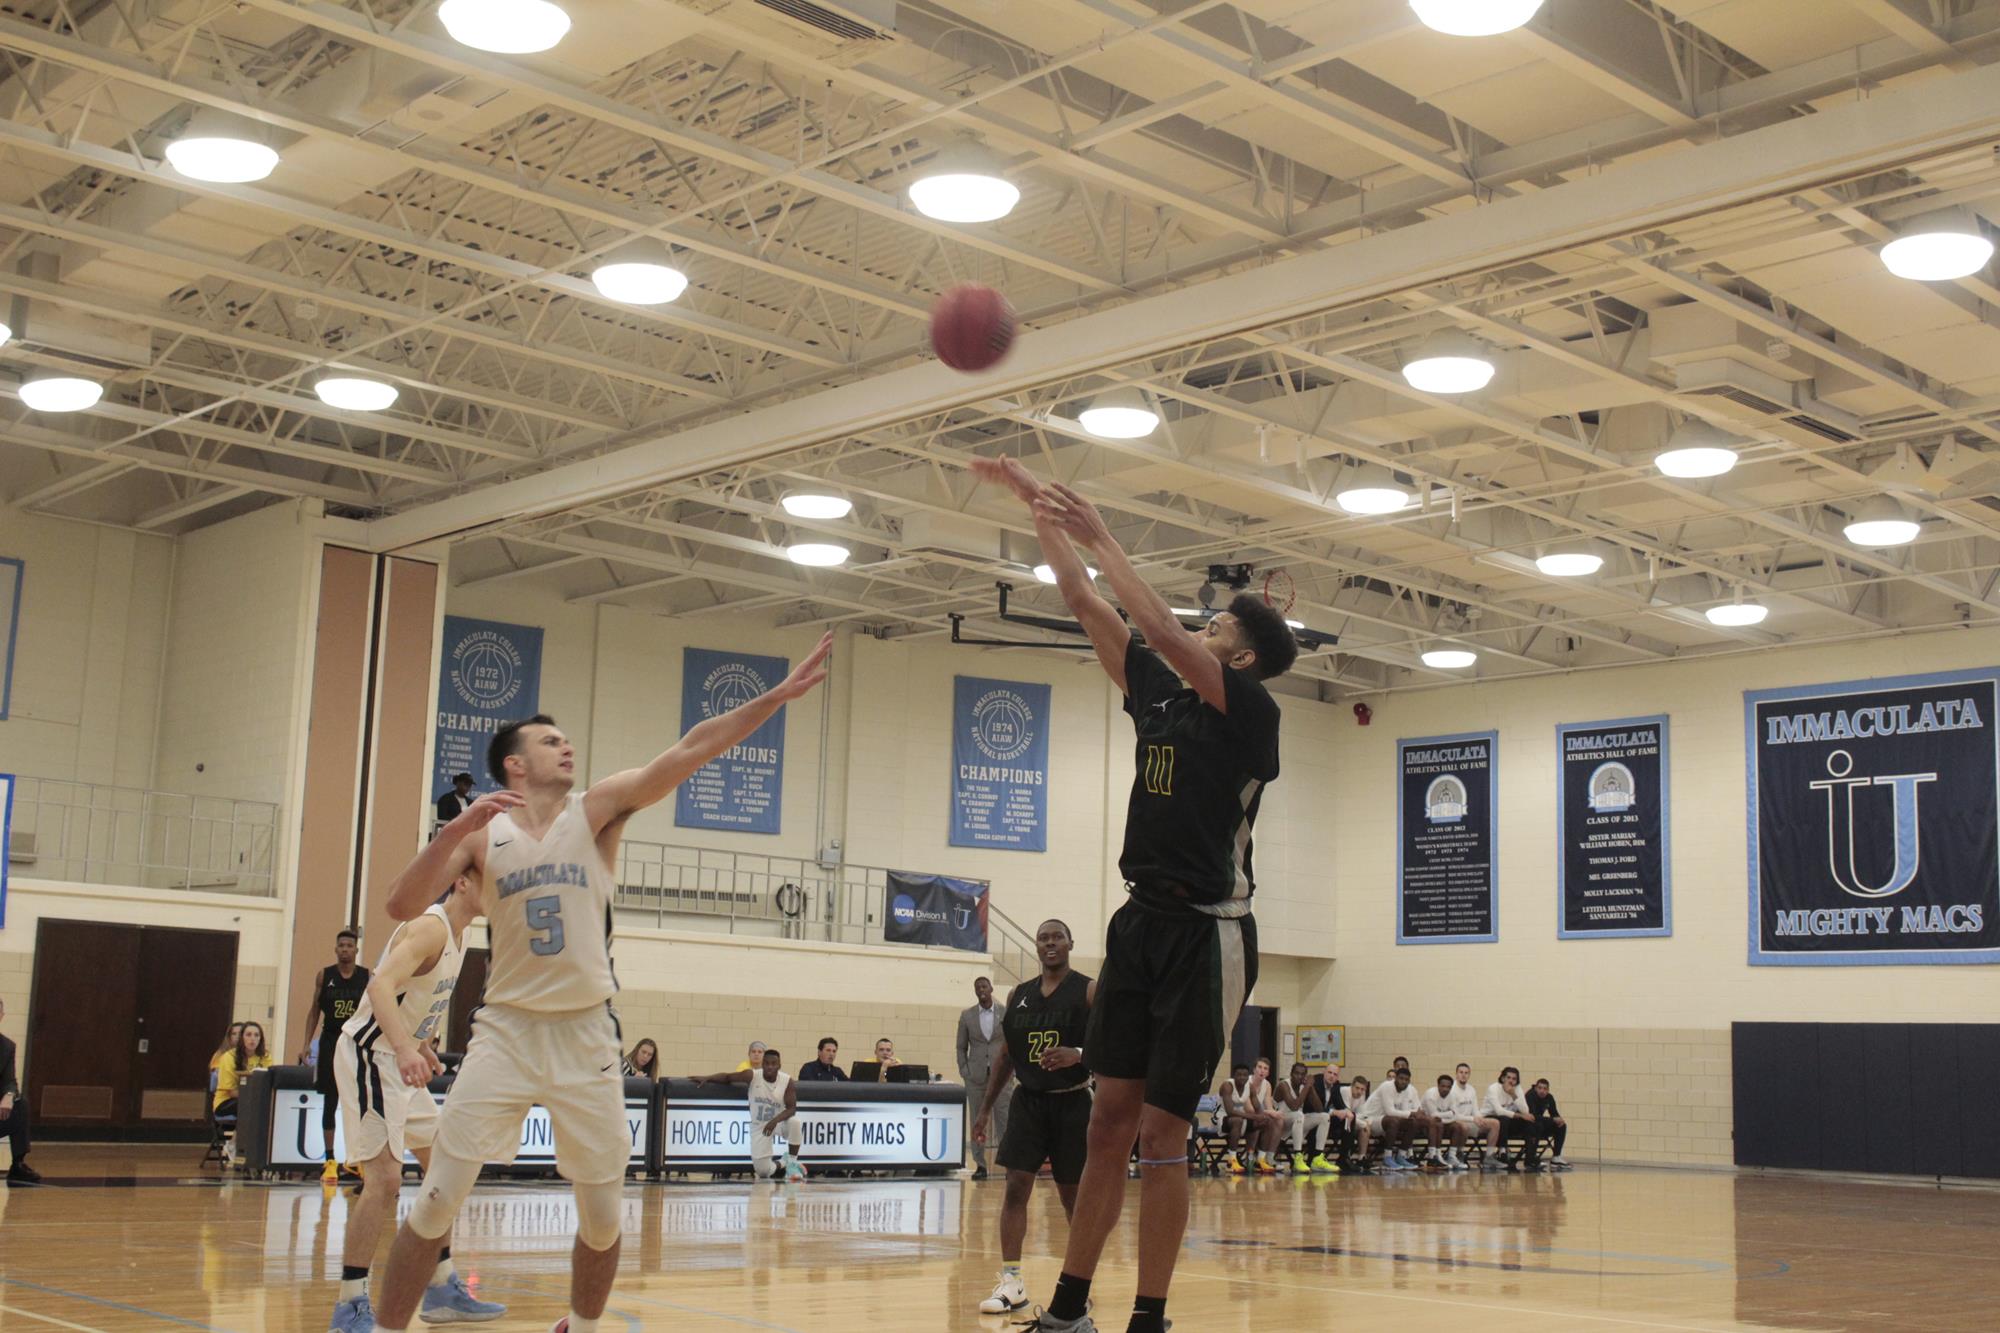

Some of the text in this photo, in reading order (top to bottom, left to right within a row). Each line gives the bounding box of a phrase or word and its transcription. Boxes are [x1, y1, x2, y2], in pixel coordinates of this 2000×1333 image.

[452, 631, 522, 667] IMMACULATA COLLEGE
[475, 666, 498, 679] 1972
[703, 664, 745, 691] IMMACULATA
[451, 670, 521, 709] NATIONAL BASKETBALL
[474, 679, 498, 690] AIAW
[972, 689, 1033, 721] IMMACULATA COLLEGE
[438, 712, 508, 734] CHAMPI
[992, 722, 1013, 733] 1974
[1766, 698, 1983, 744] IMMACULATA
[971, 726, 1034, 760] NATIONAL BASKETBALL
[991, 734, 1013, 743] AIAW
[1566, 730, 1657, 751] IMMACULATA
[720, 746, 777, 764] MPIONS
[1406, 745, 1487, 765] IMMACULATA
[1566, 747, 1658, 762] ATHLETICS HALL OF FAME
[960, 765, 1042, 785] CHAMPIONS
[1145, 745, 1174, 795] 11
[1406, 761, 1487, 774] ATHLETICS HALL OF FAME
[1587, 815, 1639, 825] CLASS OF 2013
[1579, 841, 1607, 849] WILLIAM
[894, 908, 914, 917] NCAA
[916, 910, 940, 920] Division
[1775, 904, 1983, 936] MIGHTY MACS
[526, 895, 565, 956] 5
[334, 1000, 355, 1018] 24
[1028, 1031, 1059, 1063] 22
[672, 1120, 722, 1145] HOME
[729, 1120, 750, 1145] OF
[862, 1122, 906, 1145] MACS
